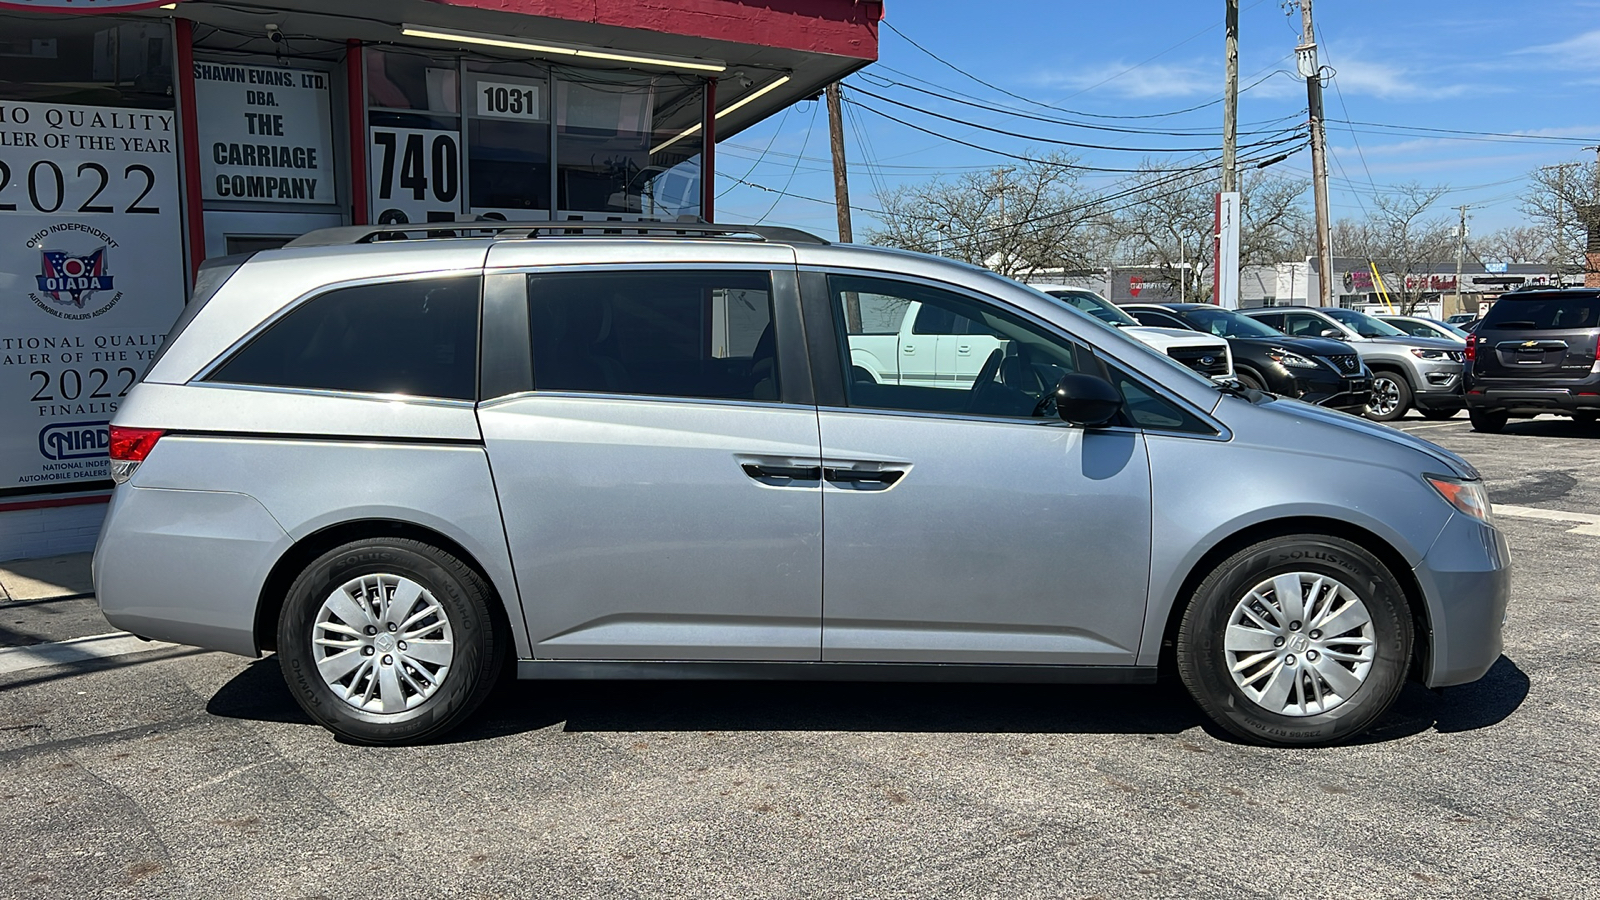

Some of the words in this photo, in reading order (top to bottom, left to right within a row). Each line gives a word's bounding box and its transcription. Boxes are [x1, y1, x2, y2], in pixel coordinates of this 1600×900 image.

[193, 64, 245, 83] SHAWN
[301, 74, 327, 90] LTD.
[246, 90, 279, 107] DBA.
[483, 87, 533, 115] 1031
[45, 109, 173, 132] QUALITY
[244, 112, 284, 136] THE
[43, 133, 70, 149] OF
[75, 135, 116, 150] THE
[120, 137, 172, 153] YEAR
[213, 142, 317, 169] CARRIAGE
[374, 132, 458, 202] 740
[0, 160, 160, 214] 2022
[216, 174, 317, 199] COMPANY
[26, 229, 49, 249] OHIO
[49, 223, 119, 249] INDEPENDENT
[46, 277, 101, 290] OIADA
[28, 292, 63, 319] AUTOMOBILE
[64, 312, 91, 321] DEALERS
[92, 291, 124, 319] ASSOCIATION
[0, 337, 85, 350] TIONAL
[61, 352, 84, 363] OF
[92, 350, 127, 362] THE
[29, 367, 137, 401] 2022
[18, 472, 71, 483] AUTOMOBILE
[73, 469, 108, 479] DEALERS
[43, 462, 83, 472] NATIONAL
[336, 552, 391, 569] SOLUS
[1279, 550, 1338, 563] SOLUS
[442, 579, 471, 630] KUMHO
[292, 658, 321, 708] KUMHO
